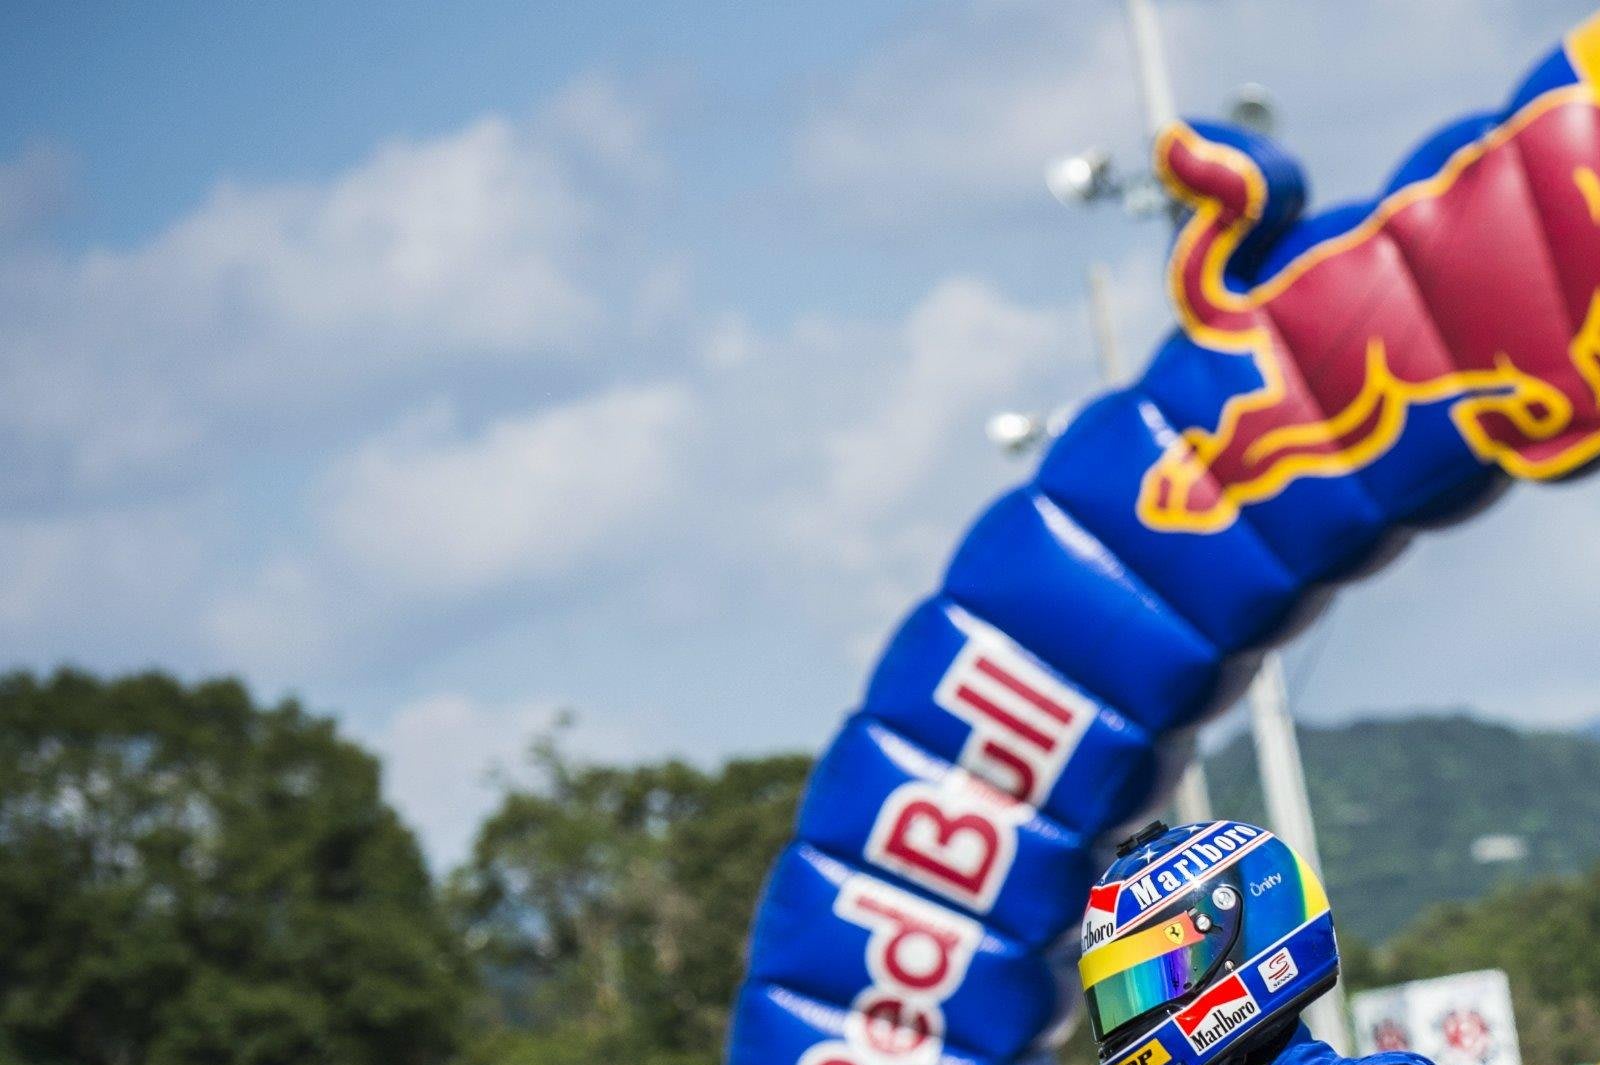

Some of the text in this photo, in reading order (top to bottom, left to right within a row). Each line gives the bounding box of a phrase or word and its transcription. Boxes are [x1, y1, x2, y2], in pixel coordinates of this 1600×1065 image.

[881, 654, 1077, 899] Bull
[1129, 821, 1259, 910] Marlboro
[1189, 999, 1256, 1052] Marlboro
